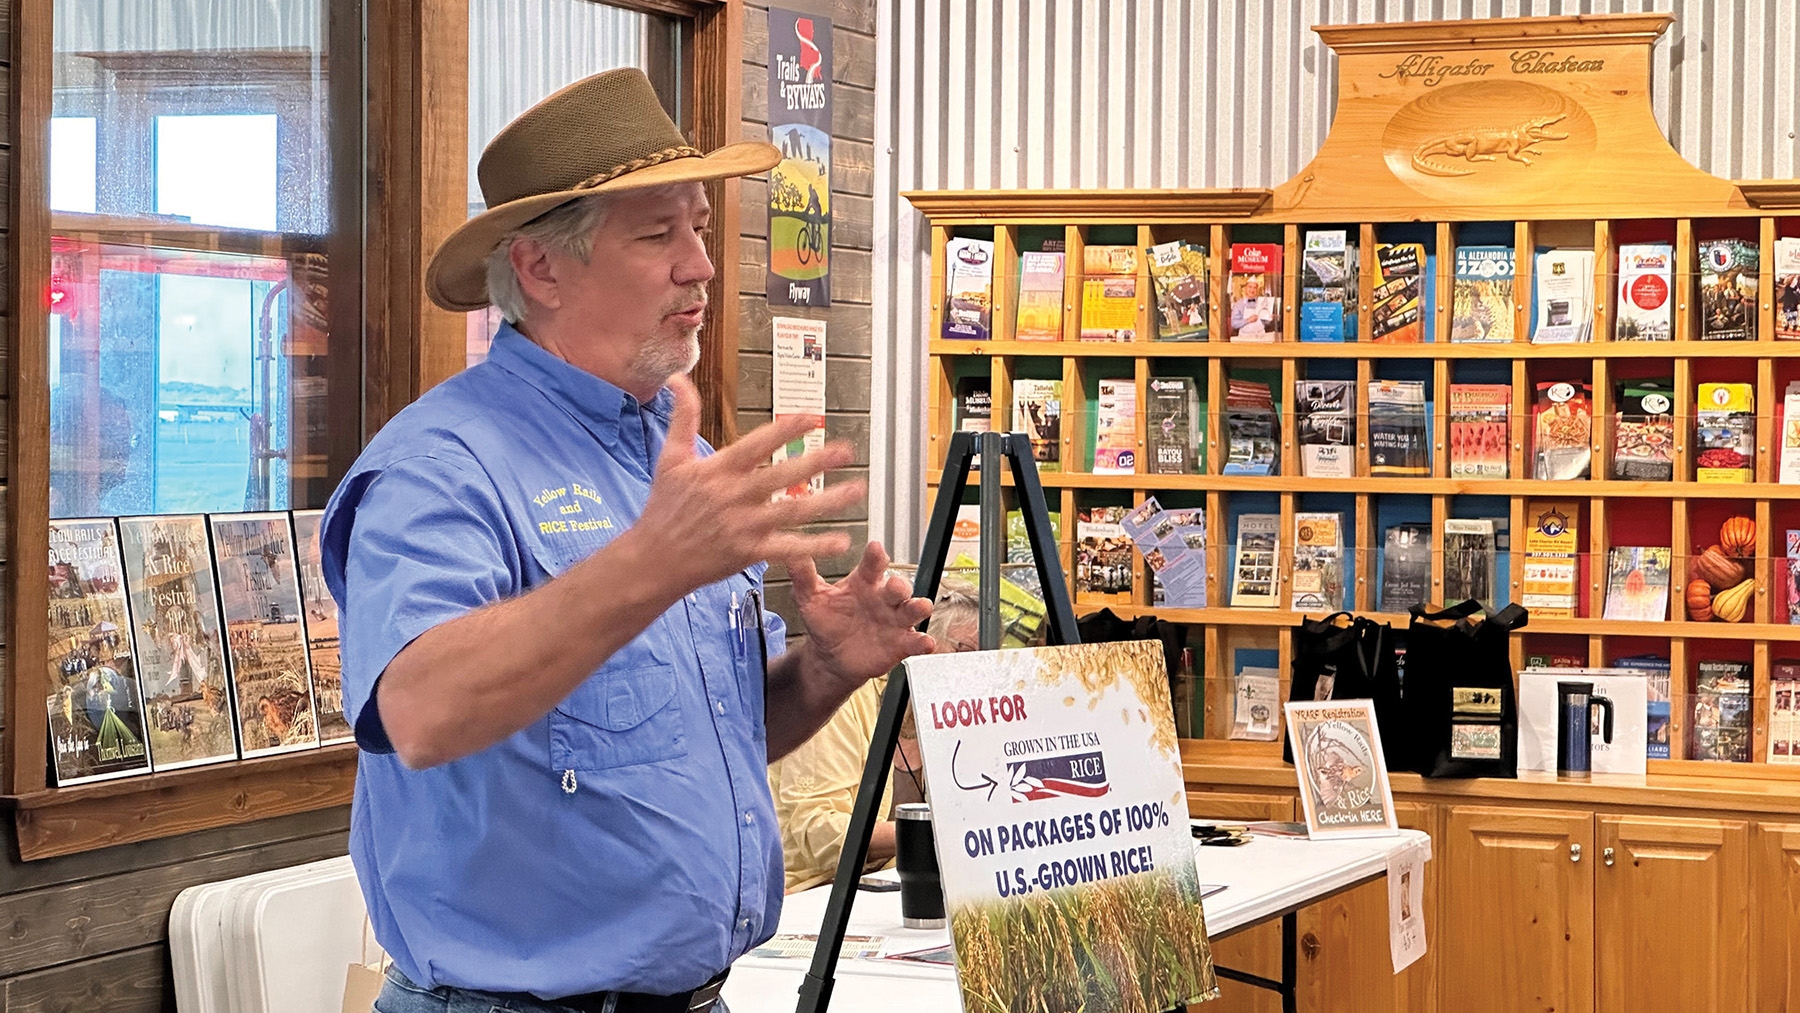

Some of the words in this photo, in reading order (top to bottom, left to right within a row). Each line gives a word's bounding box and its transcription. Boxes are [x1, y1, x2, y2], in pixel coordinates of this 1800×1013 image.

[776, 54, 800, 82] Trails
[1379, 54, 1495, 87] Alligator
[1510, 50, 1605, 75] Chateau
[780, 81, 786, 98] &
[786, 83, 826, 110] BYWAYS
[1237, 255, 1268, 263] MUSEUM
[1243, 248, 1262, 257] Coke
[1468, 250, 1508, 260] ALEXANDRIA
[788, 282, 811, 303] Flyway
[1158, 455, 1182, 463] BLISS
[533, 487, 566, 507] Yellow
[572, 483, 602, 504] Rails
[560, 500, 582, 514] and
[75, 528, 101, 541] RAILS
[539, 521, 568, 534] RICE
[569, 517, 614, 531] Festival
[49, 549, 71, 563] RICE
[73, 546, 115, 561] FESTIVAL
[149, 555, 159, 575] &
[163, 554, 190, 575] Rice
[148, 584, 197, 607] Festival
[931, 698, 986, 730] LOOK
[989, 694, 1028, 723] FOR
[1321, 708, 1366, 721] Registration
[1325, 720, 1353, 736] Yellow
[1003, 738, 1043, 757] GROWN
[1045, 737, 1057, 752] IN
[1059, 734, 1081, 751] THE
[1083, 732, 1101, 747] USA
[1069, 757, 1103, 779] RICE
[1348, 787, 1370, 808] Rice
[1318, 811, 1358, 824] Check-in
[1360, 810, 1383, 822] HERE
[964, 828, 994, 858] ON
[997, 812, 1096, 853] PACKAGES
[1099, 809, 1122, 836] OF
[1125, 801, 1169, 831] 100%
[995, 854, 1108, 898] U.S.-GROWN
[1111, 845, 1154, 878] RICE!
